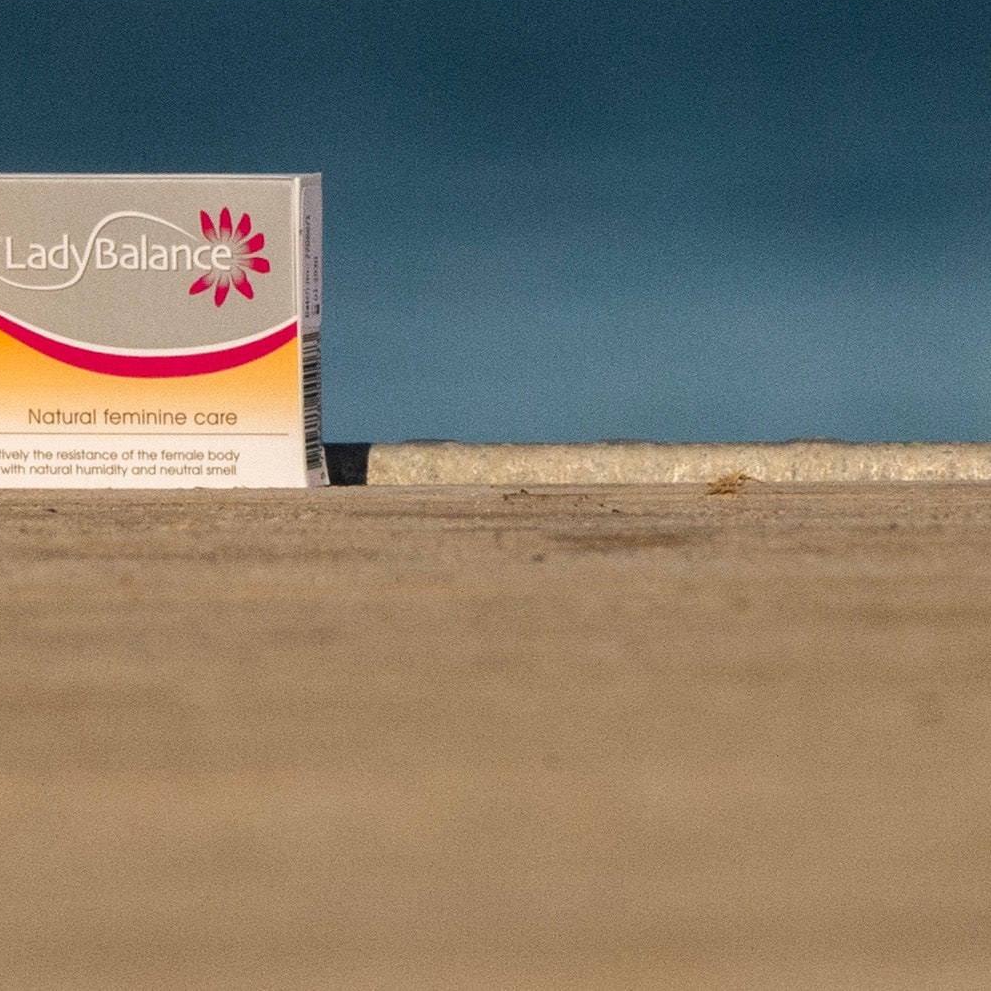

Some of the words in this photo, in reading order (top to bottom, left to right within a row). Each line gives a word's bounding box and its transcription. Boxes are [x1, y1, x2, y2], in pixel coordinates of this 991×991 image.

[1, 226, 233, 289] LadyBalance
[28, 409, 96, 425] Natural
[104, 408, 187, 425] feminine
[194, 412, 238, 425] care
[33, 449, 53, 460] the
[56, 449, 118, 460] resistance
[121, 449, 134, 460] of
[137, 449, 158, 460] the
[161, 450, 204, 461] female
[208, 450, 240, 463] body
[0, 464, 25, 475] with
[29, 464, 72, 475] natural
[76, 464, 127, 477] humidity
[131, 464, 156, 476] and
[160, 465, 203, 476] neutral
[206, 465, 237, 476] smell
